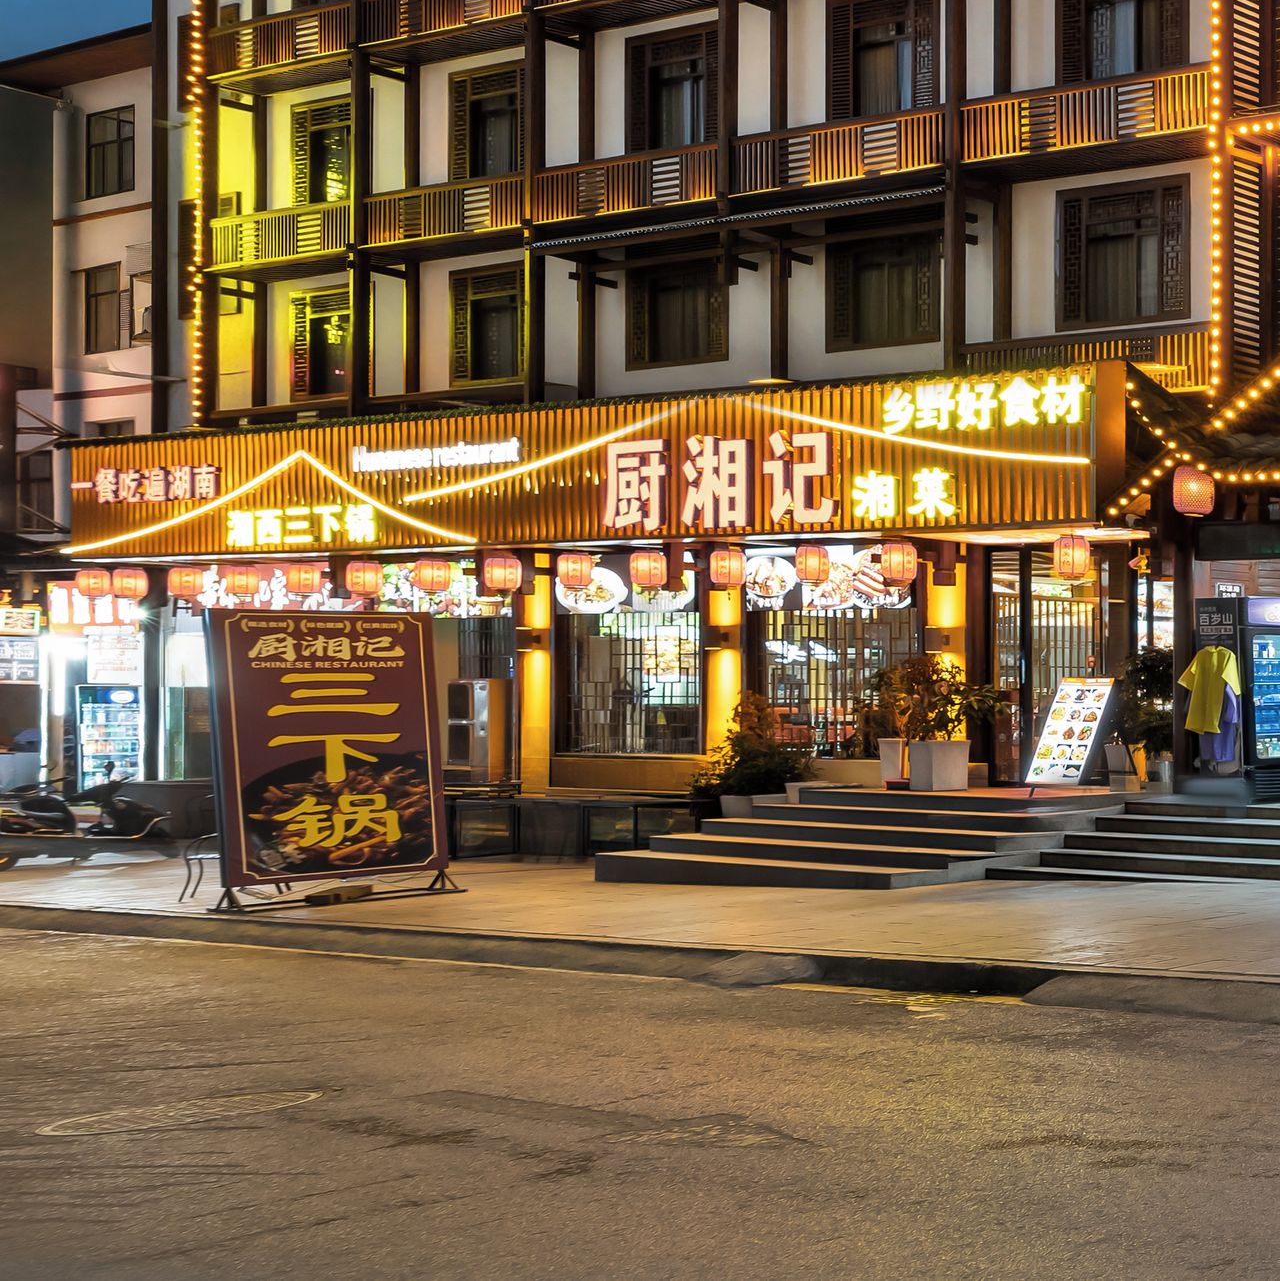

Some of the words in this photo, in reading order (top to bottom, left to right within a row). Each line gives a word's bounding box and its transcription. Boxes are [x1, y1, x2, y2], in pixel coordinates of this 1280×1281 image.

[882, 377, 1086, 434] 乡野好食材
[71, 463, 219, 503] 一餐吃遍湖南
[602, 430, 836, 530] 厨湘记
[852, 467, 957, 522] 湘菜
[1199, 613, 1233, 625] 百岁山
[248, 633, 405, 662] 厨湘记
[251, 661, 313, 669] CHINESE
[315, 660, 404, 669] RESTAURANT
[267, 673, 402, 848] 三下锅
